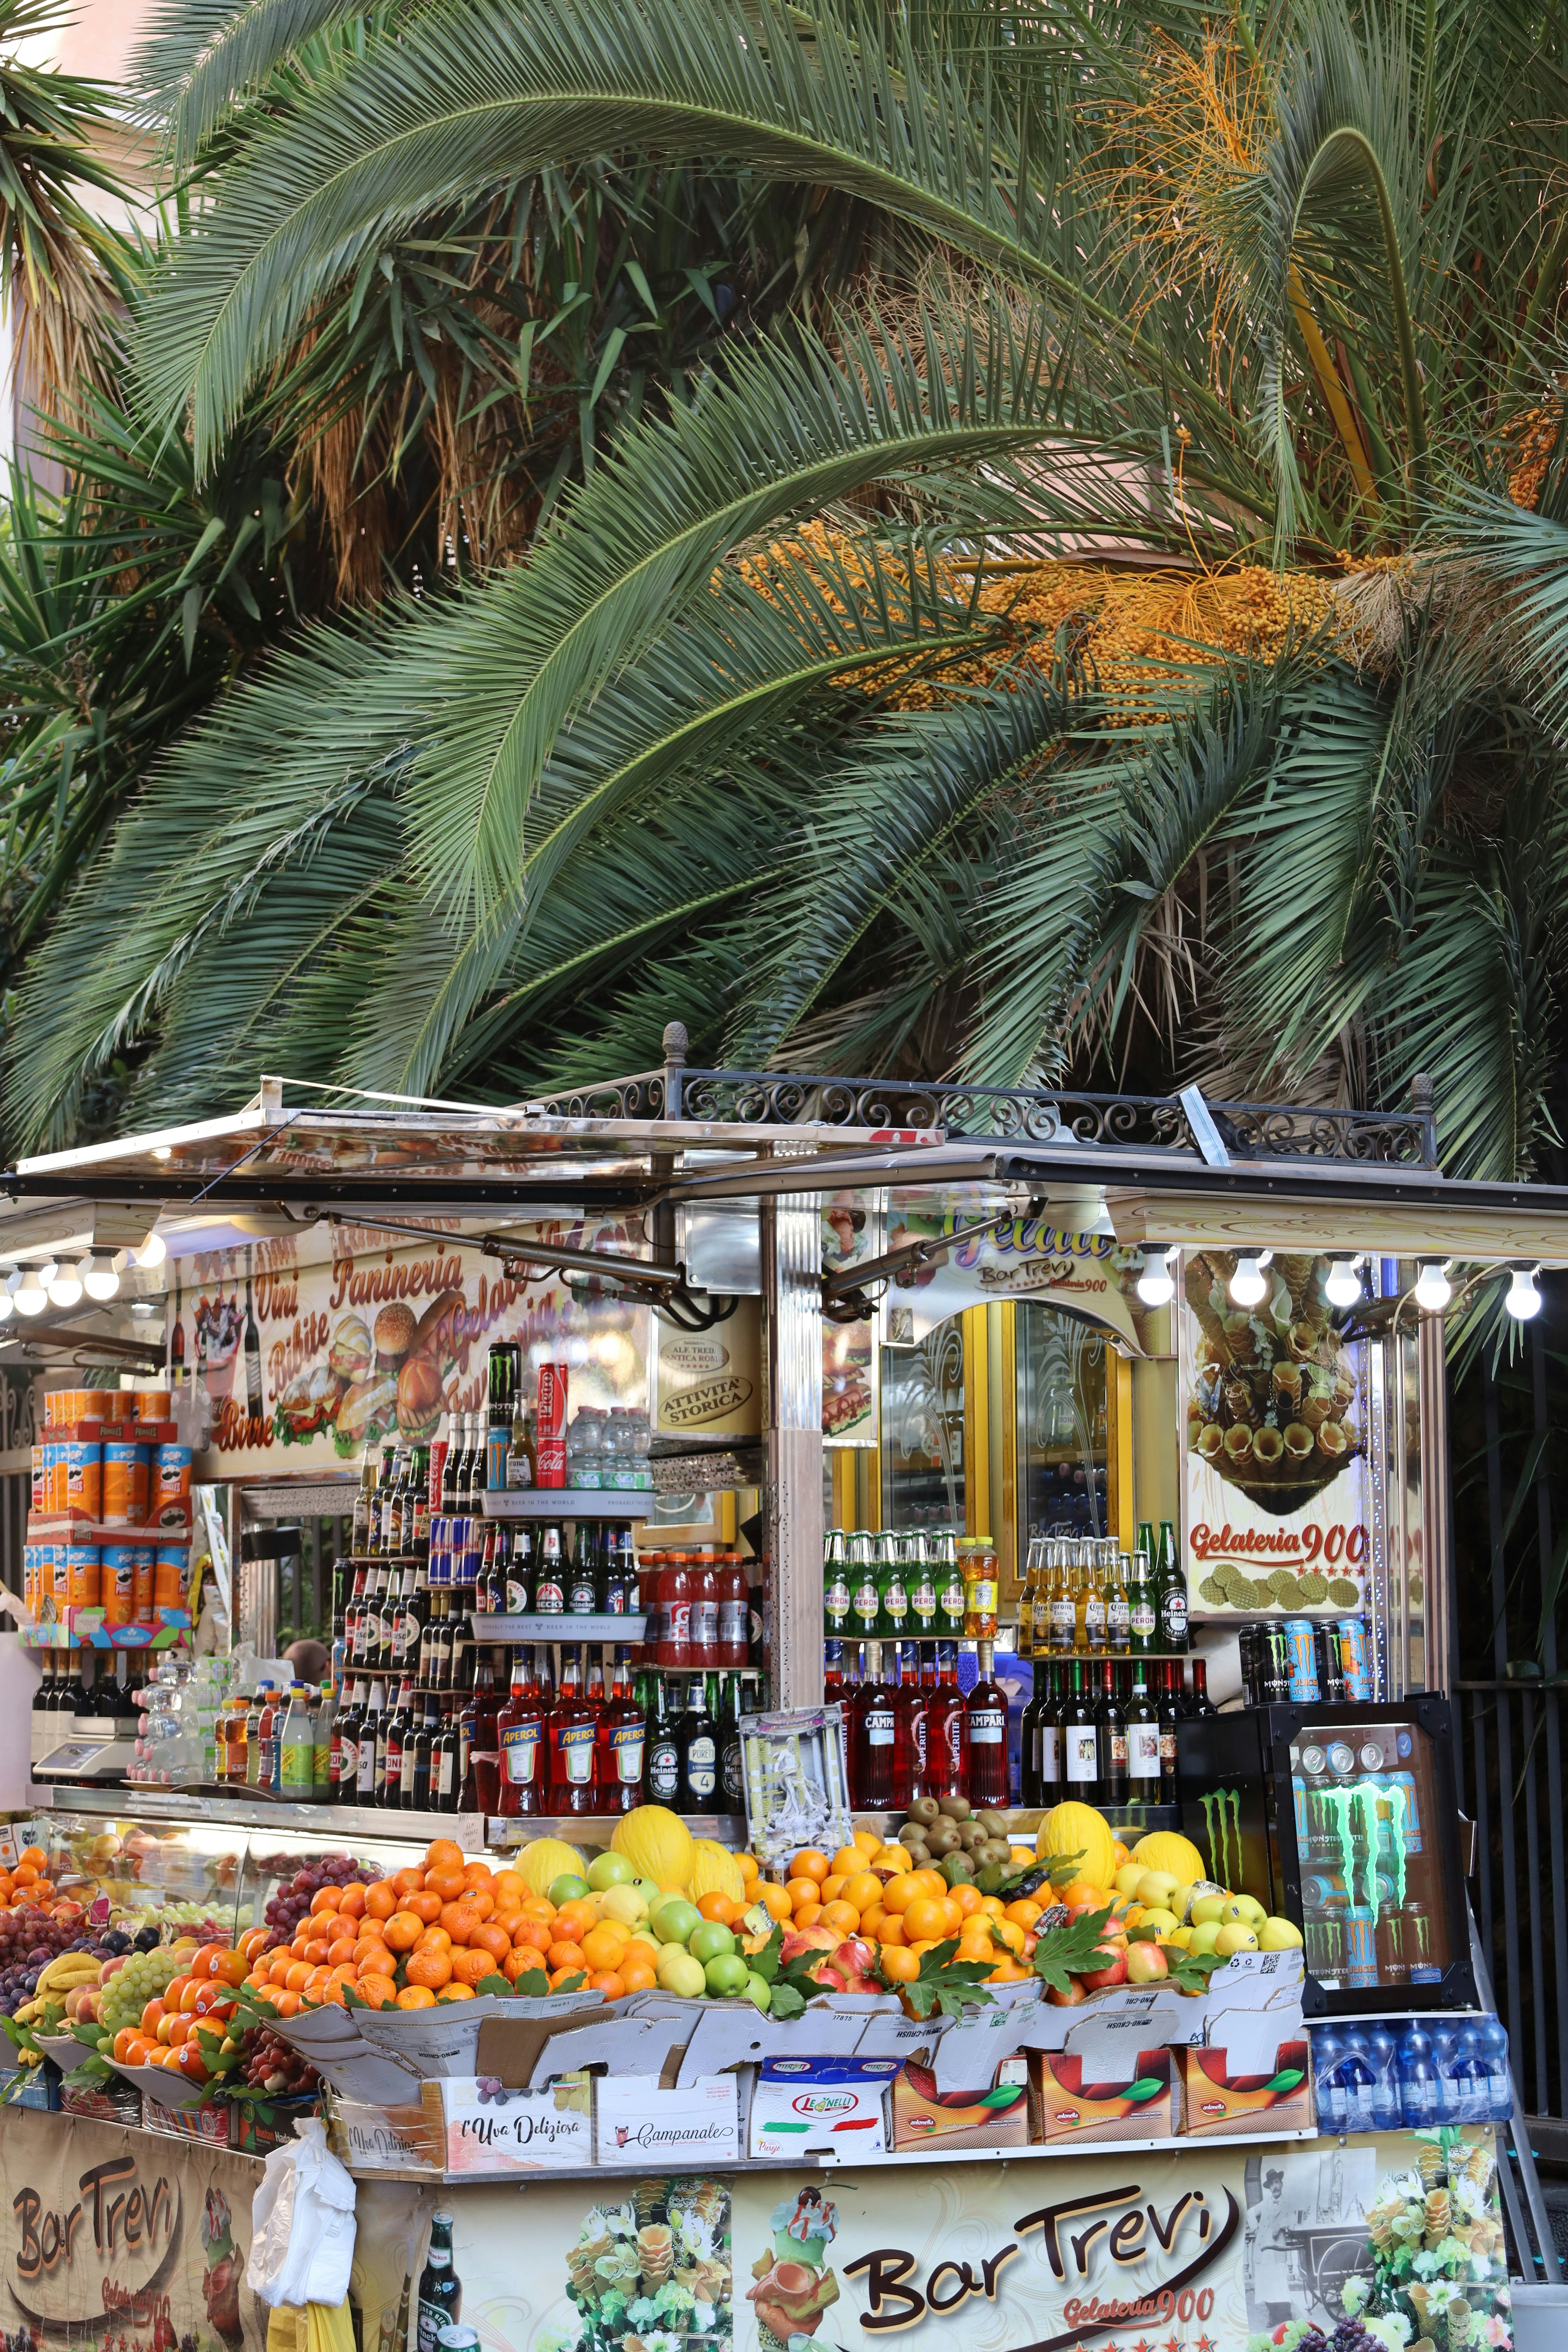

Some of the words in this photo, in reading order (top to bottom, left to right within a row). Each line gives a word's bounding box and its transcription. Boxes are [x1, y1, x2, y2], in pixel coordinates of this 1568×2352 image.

[330, 1243, 463, 1309] Panineria
[977, 1267, 1019, 1283] Bar
[1019, 1259, 1067, 1276] Trevi
[255, 1269, 299, 1321] Vini
[1084, 1279, 1107, 1292] 900
[269, 1311, 329, 1401] Bibite
[539, 1372, 553, 1418] Pietro
[670, 1392, 743, 1423] STORICA
[219, 1399, 274, 1452] Birre
[160, 1481, 181, 1493] PRINGLES
[1190, 1522, 1301, 1559] Gelateria
[1299, 1524, 1366, 1563] 900
[1033, 1603, 1047, 1612] Coro
[1049, 1602, 1072, 1612] Corona
[1089, 1602, 1104, 1612] Coro
[1264, 1678, 1290, 1688] MONST
[865, 1717, 894, 1728] CAMPA
[503, 1727, 538, 1745] APEROL
[562, 1727, 595, 1745] APEROL
[614, 1728, 645, 1744] APEROL
[918, 1720, 926, 1764] APERITIF
[700, 1773, 709, 1788] 4
[896, 2030, 932, 2038] NO-CRUSH
[1107, 2020, 1143, 2029] NO-CRUSH
[256, 2125, 275, 2141] Bustan
[514, 2115, 582, 2144] Deliziosa
[638, 2122, 733, 2148] Campanale
[14, 2187, 82, 2277] Bar
[79, 2156, 170, 2255] Trevi
[843, 2248, 1021, 2334] Bar
[1014, 2185, 1211, 2282] Trevi
[1063, 2295, 1159, 2329] Gelateria
[1158, 2286, 1214, 2324] 900
